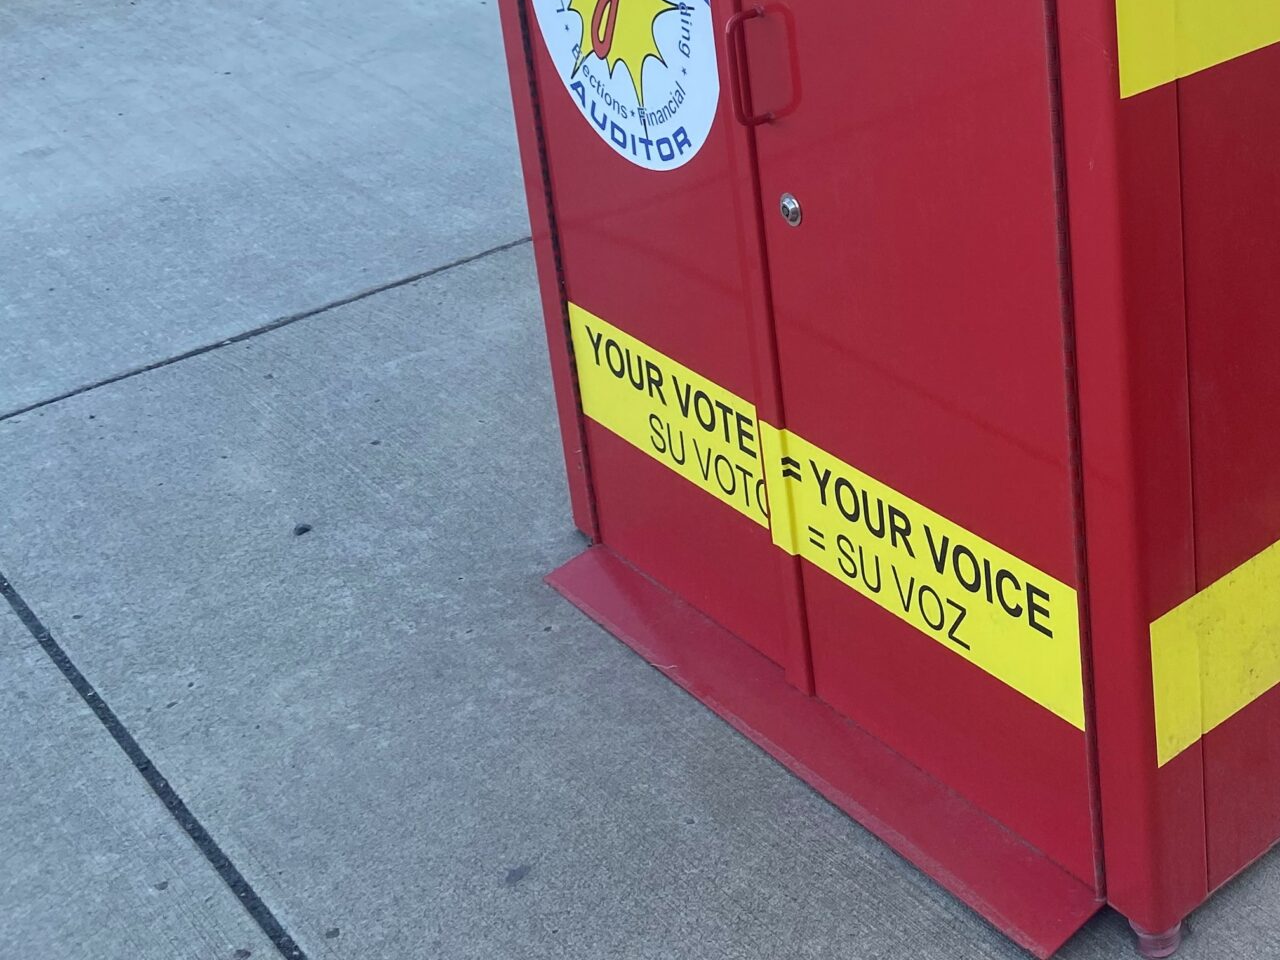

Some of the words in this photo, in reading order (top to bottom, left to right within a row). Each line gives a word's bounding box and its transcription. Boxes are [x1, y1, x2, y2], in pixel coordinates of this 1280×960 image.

[570, 80, 692, 161] AUDITOR
[637, 80, 686, 126] Financial
[585, 325, 667, 406] YOUR
[672, 374, 758, 459] VOTE
[781, 456, 802, 482] =
[809, 458, 917, 559] YOUR
[923, 523, 1054, 640] VOICE
[648, 413, 687, 466] SU
[807, 525, 826, 551] =
[836, 534, 883, 594] SU
[891, 564, 971, 651] VOZ
